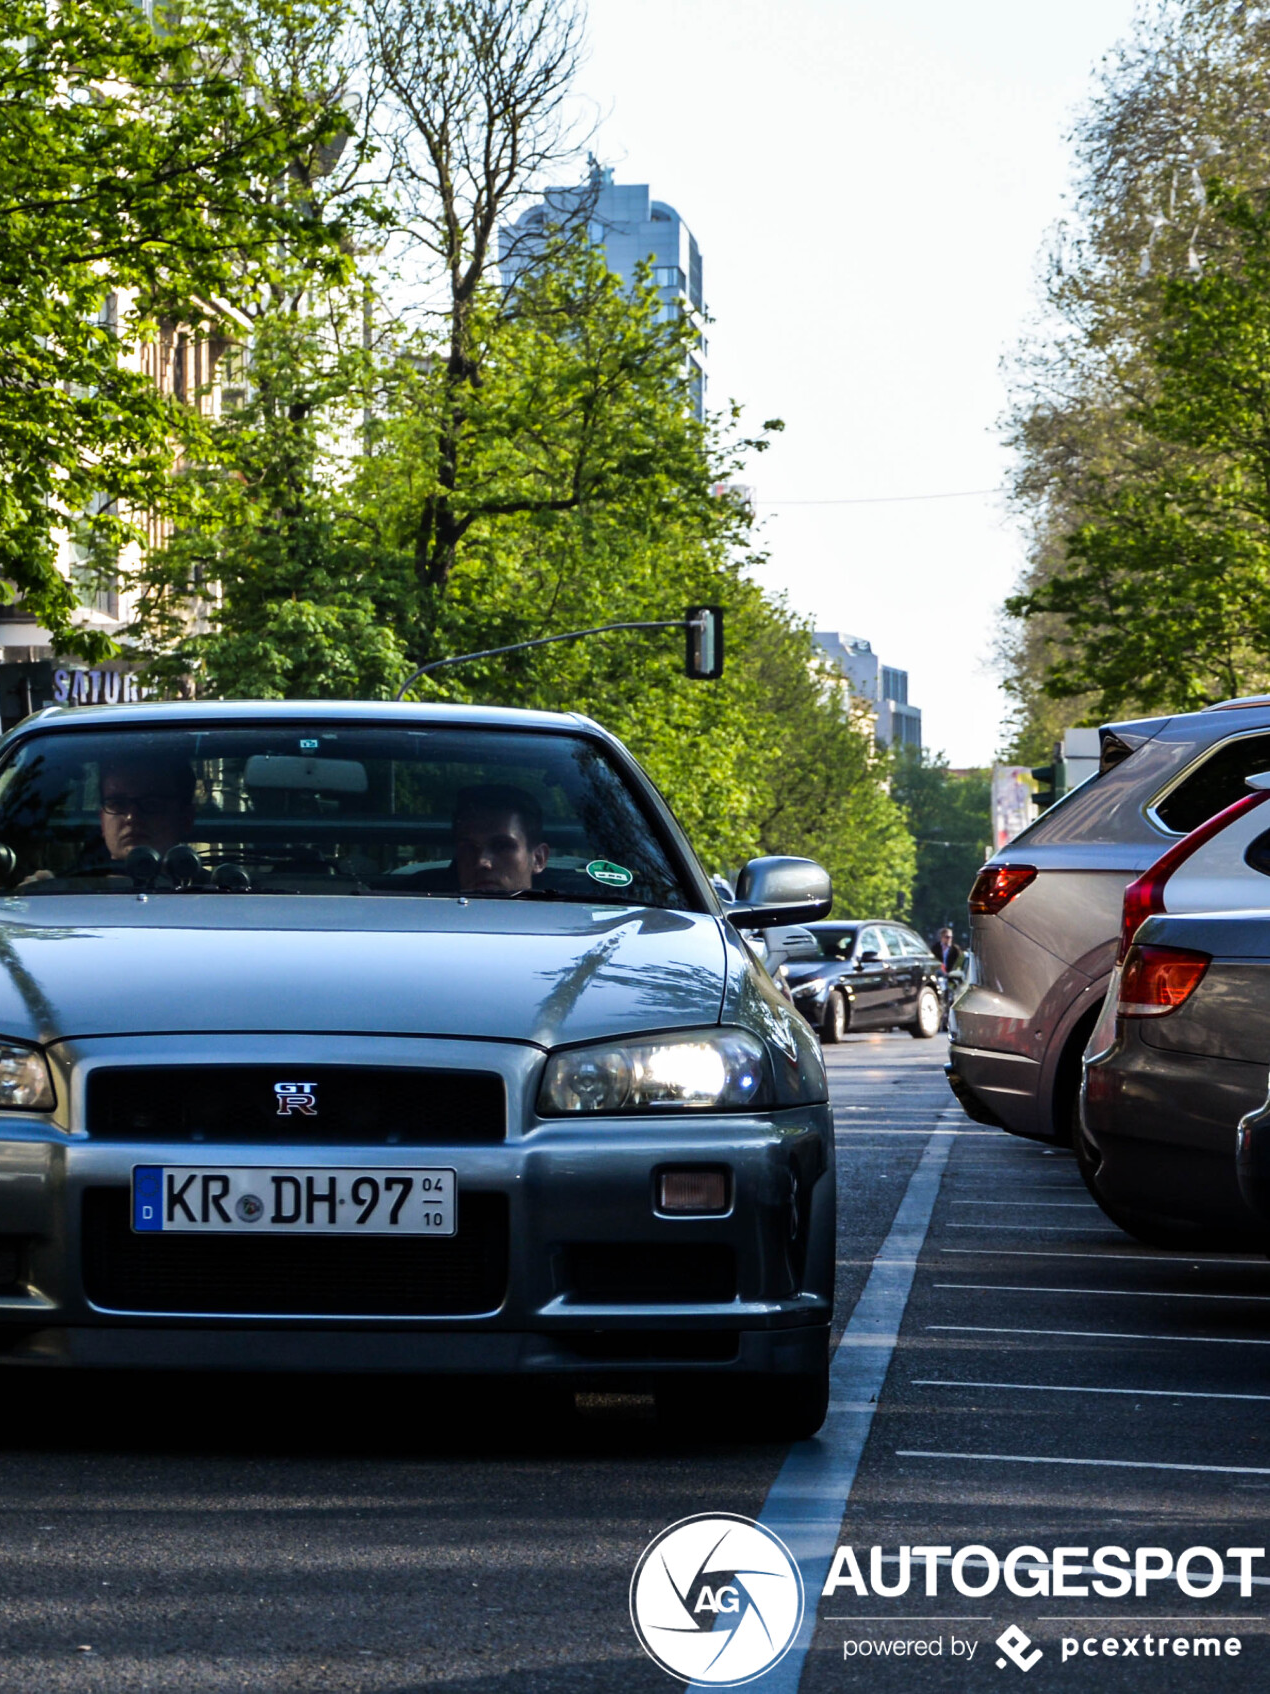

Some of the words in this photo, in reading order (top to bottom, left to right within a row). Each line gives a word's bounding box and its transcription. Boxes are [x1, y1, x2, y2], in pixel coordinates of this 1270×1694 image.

[274, 1082, 318, 1093] GT
[276, 1093, 318, 1115] R
[422, 1178, 443, 1192] 04
[167, 1174, 232, 1223] KR
[142, 1205, 153, 1220] D
[423, 1212, 443, 1226] 10
